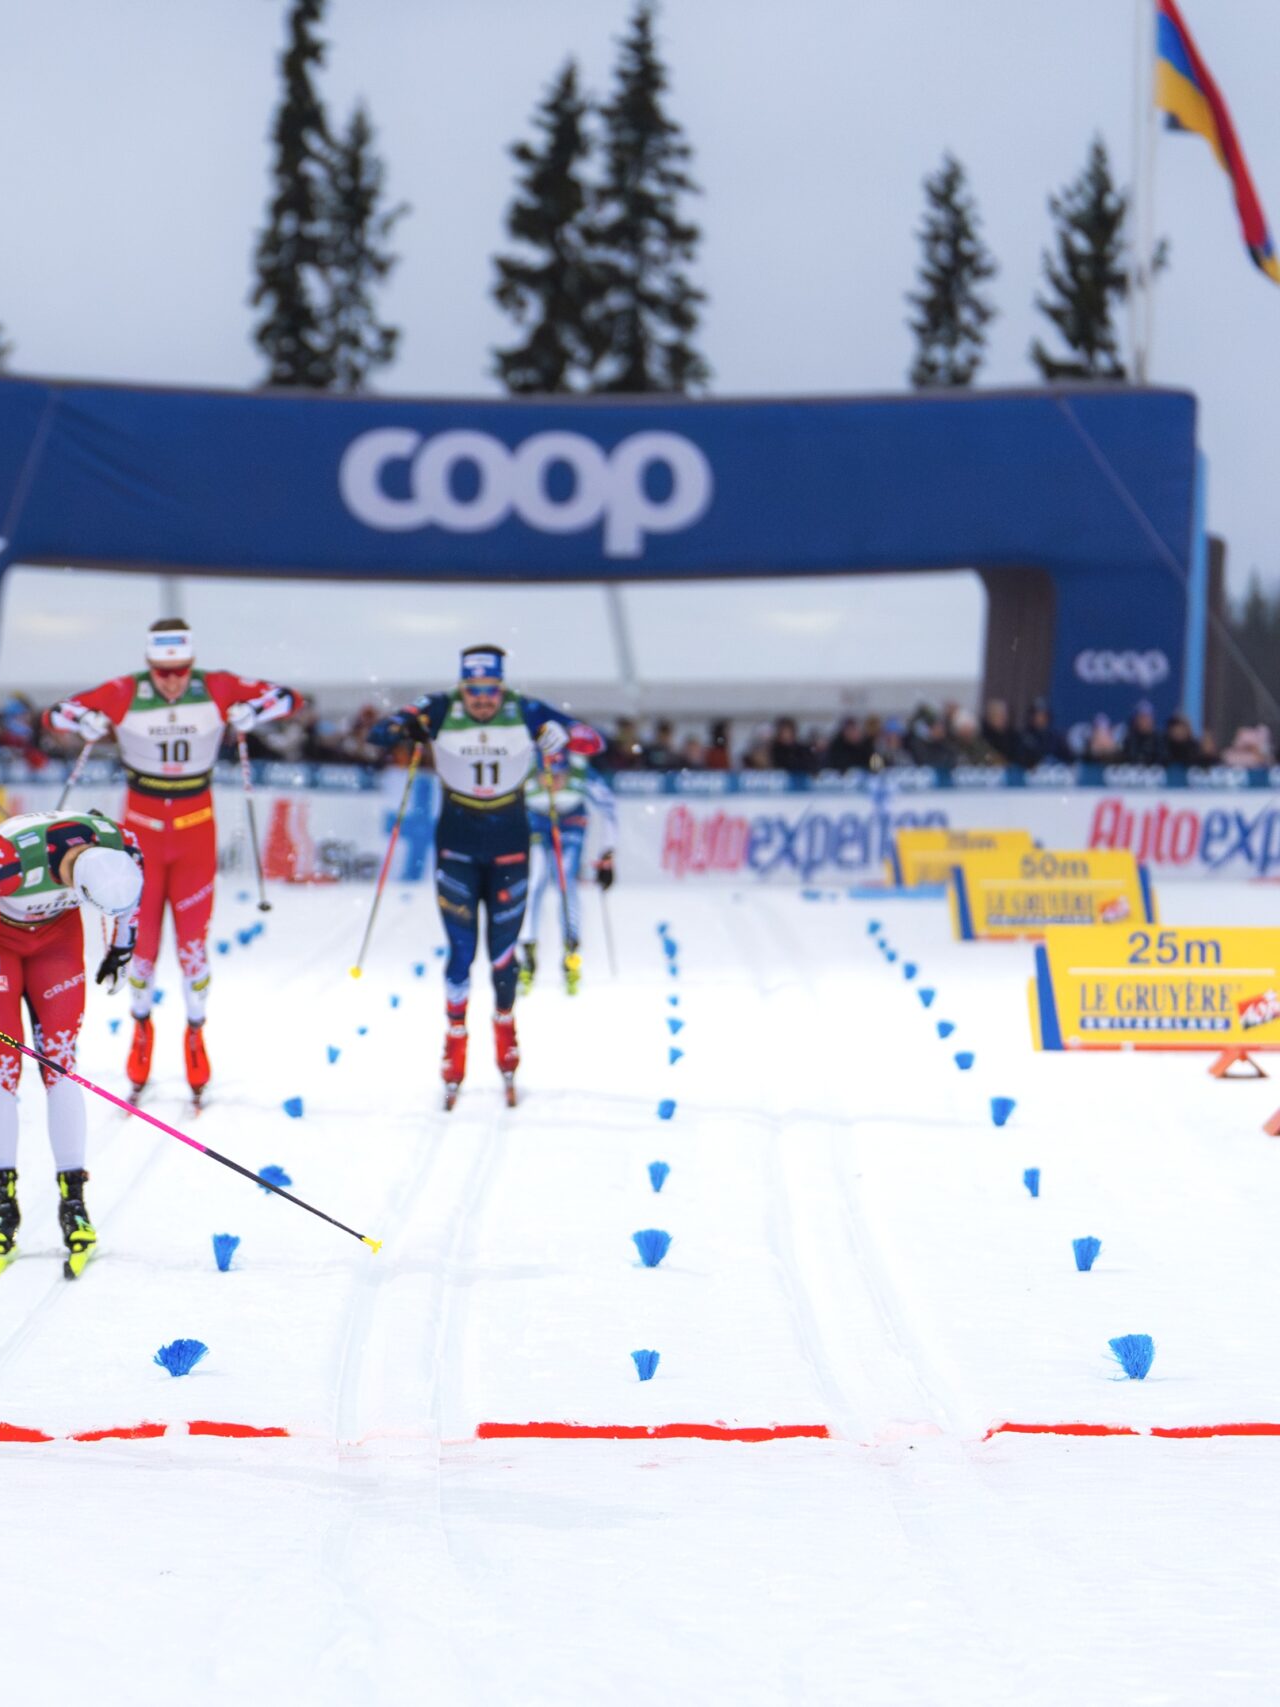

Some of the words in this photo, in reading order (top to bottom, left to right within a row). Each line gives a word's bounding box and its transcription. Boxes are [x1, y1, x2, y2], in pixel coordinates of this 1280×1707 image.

[339, 426, 713, 558] coop
[1074, 650, 1170, 688] coop
[155, 739, 190, 763] 10
[471, 760, 500, 785] 11
[1021, 855, 1089, 878] 50m
[1128, 932, 1223, 964] 25m
[1080, 983, 1108, 1012] LE
[1116, 978, 1232, 1012] GRUYÈRE
